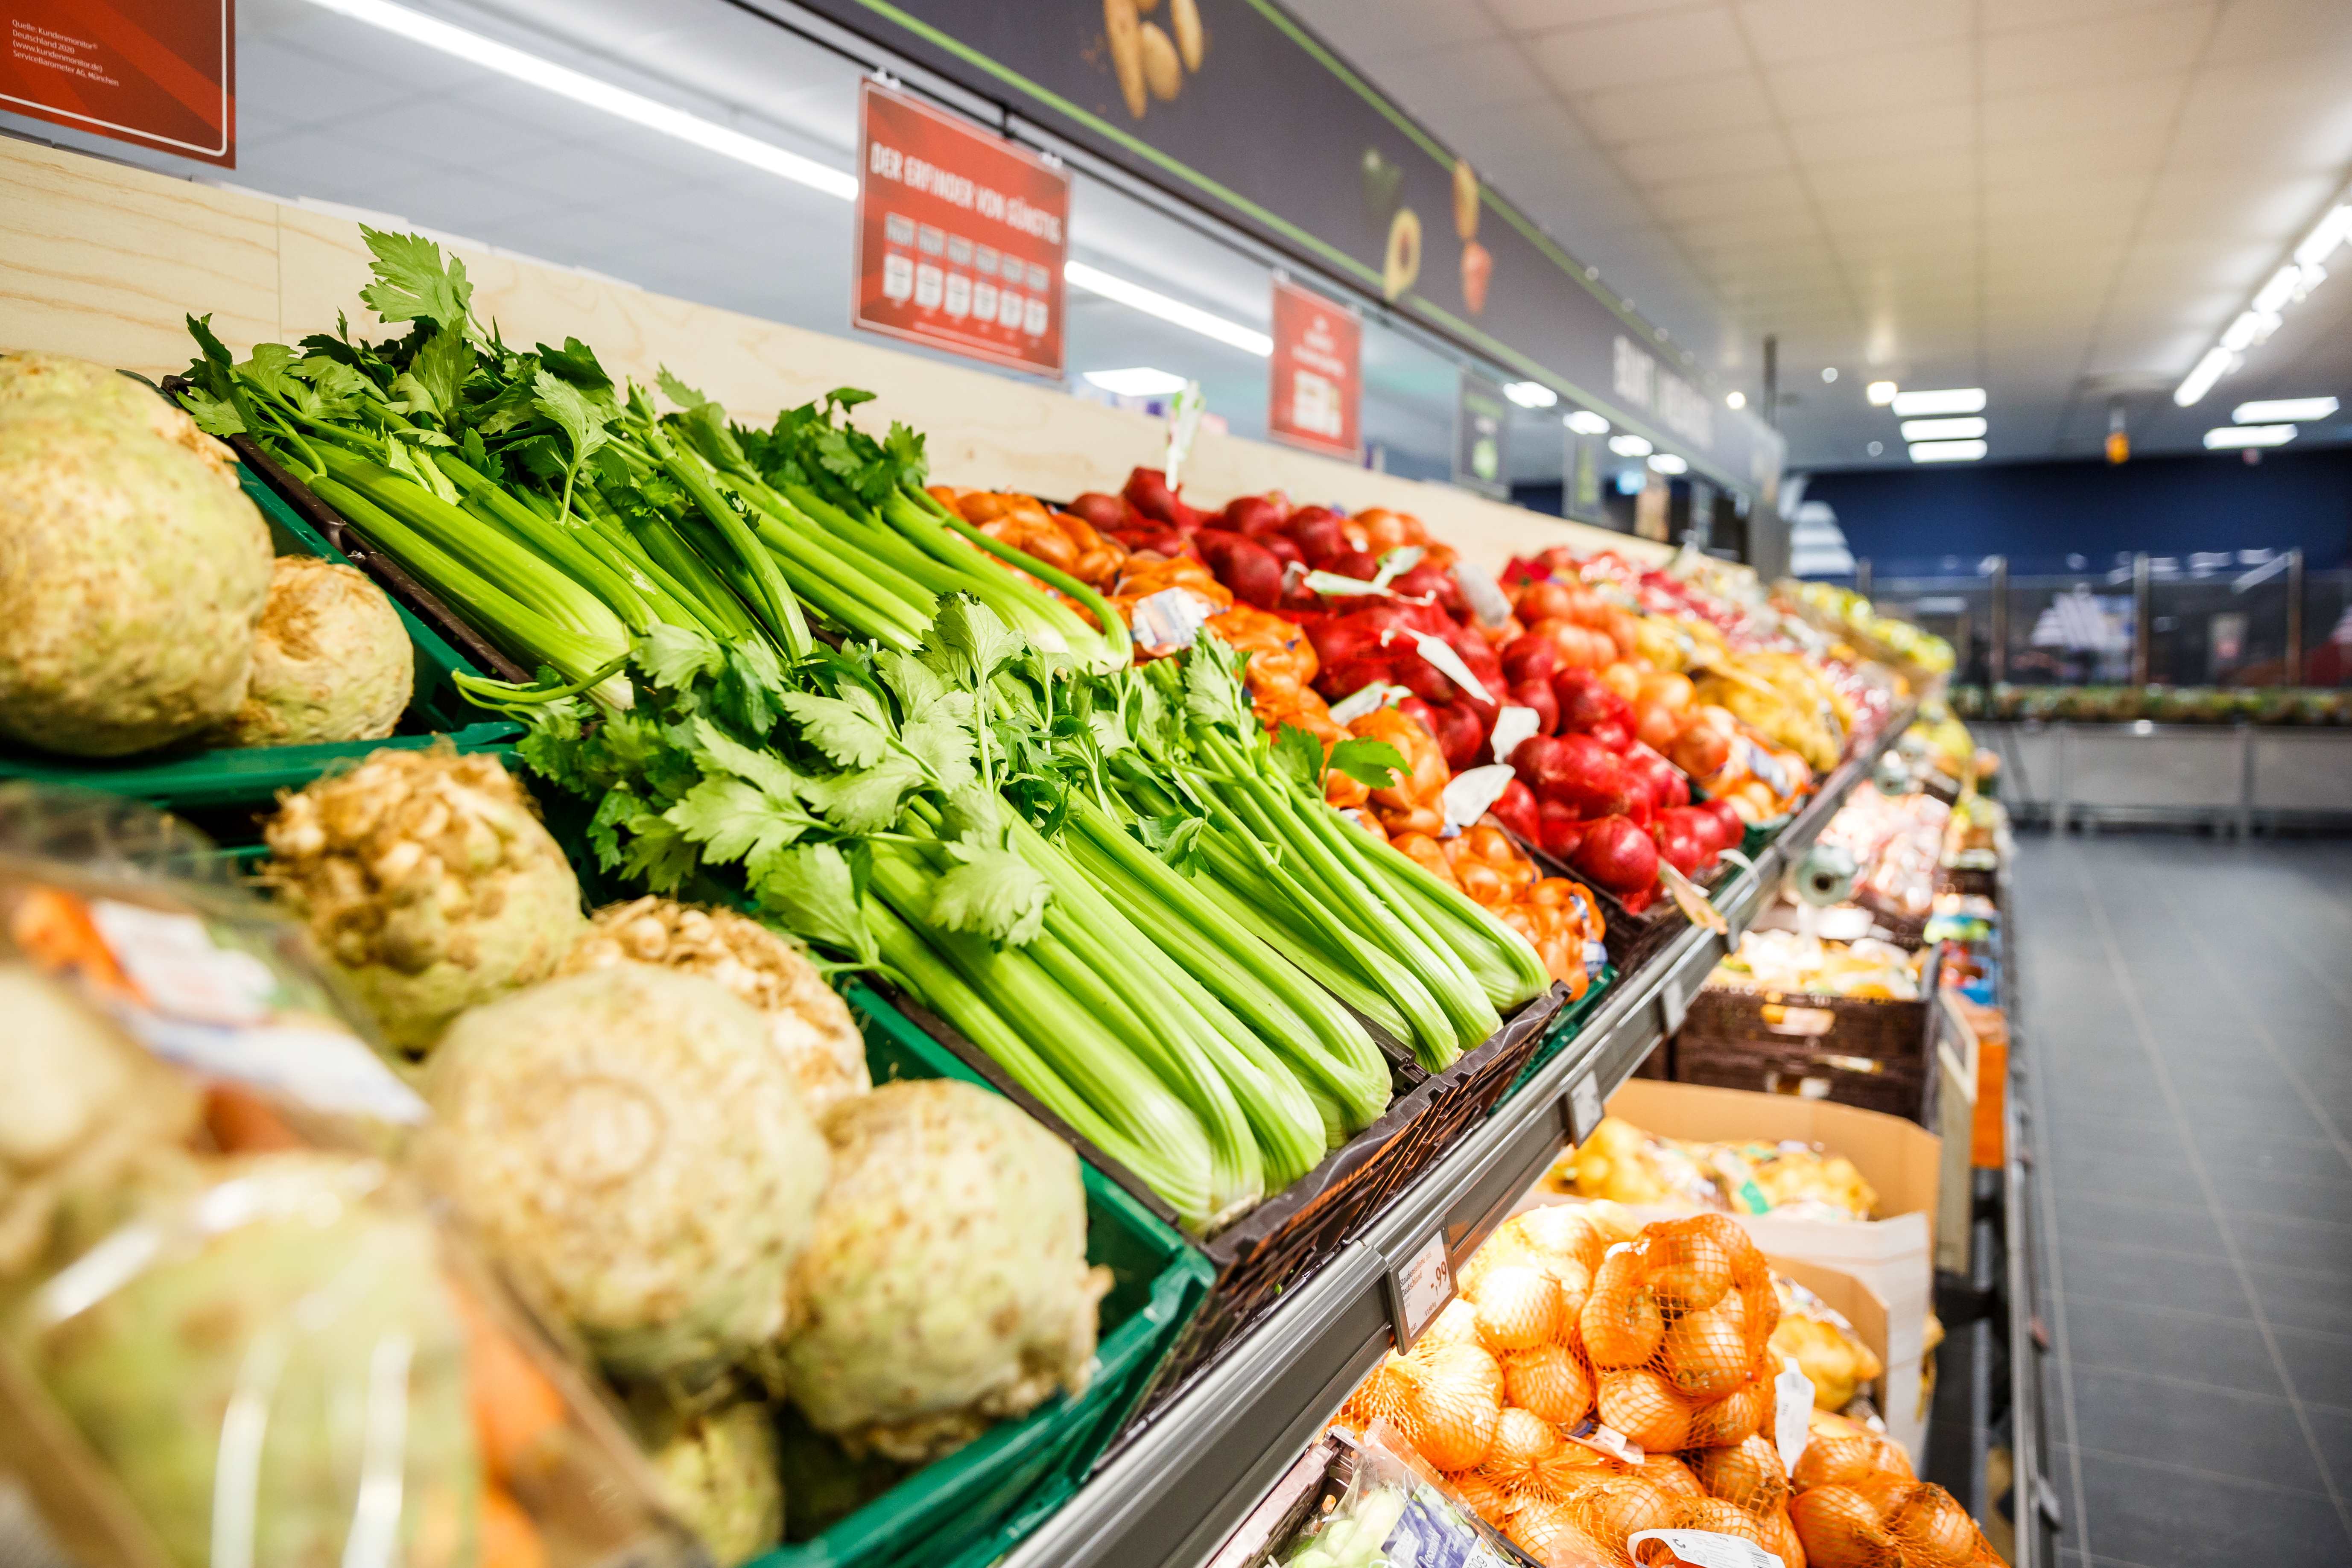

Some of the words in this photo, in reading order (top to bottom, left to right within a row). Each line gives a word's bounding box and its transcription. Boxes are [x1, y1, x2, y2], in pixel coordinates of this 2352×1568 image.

[12, 19, 37, 32] Quelle:
[12, 29, 57, 49] Deutschland
[57, 44, 75, 54] 2020
[13, 39, 102, 73] (www.kundenmonitor.de)
[13, 50, 74, 74] ServiceBarometer
[88, 71, 119, 87] München
[870, 141, 904, 182] DER
[976, 187, 1005, 220] VON
[1400, 1256, 1426, 1287] Staudensellerie
[1402, 1270, 1423, 1297] Deutschland
[1418, 1527, 1441, 1568] Rosenkohl
[1467, 1555, 1487, 1568] 00g
